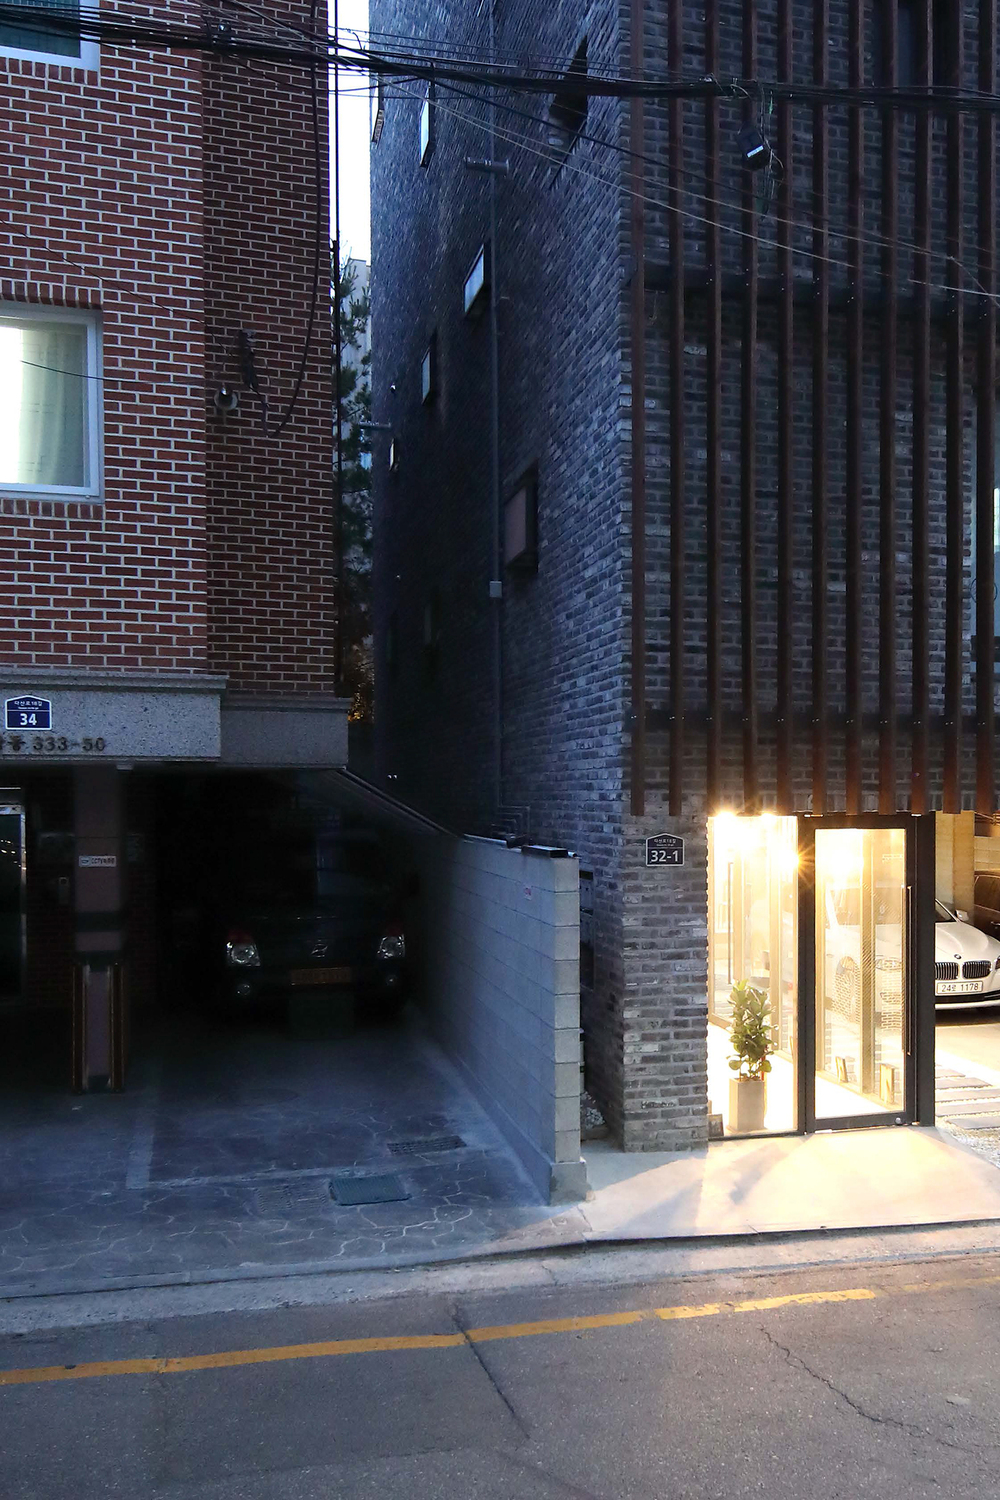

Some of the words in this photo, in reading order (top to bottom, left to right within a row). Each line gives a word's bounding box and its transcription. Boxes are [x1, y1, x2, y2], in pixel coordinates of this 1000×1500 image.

[20, 712, 38, 726] 34
[33, 736, 106, 752] 333-50
[650, 850, 679, 862] 32-1
[960, 982, 980, 992] 1178
